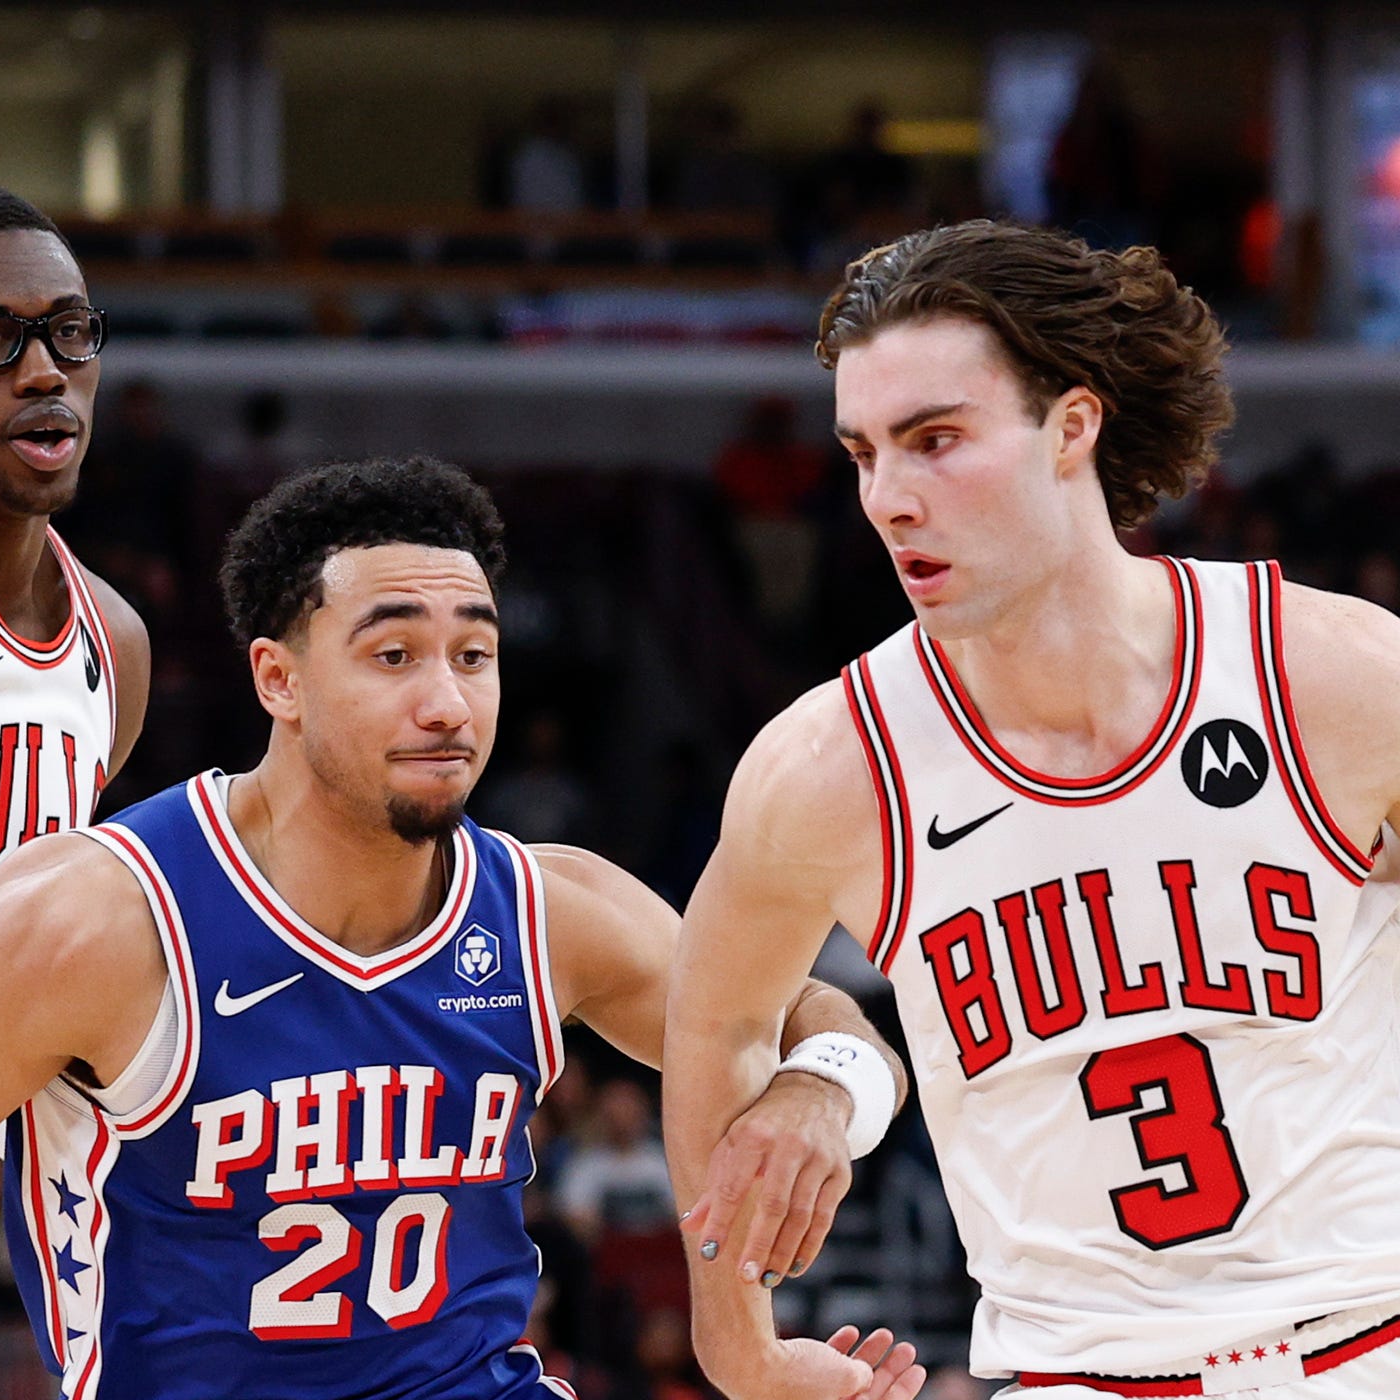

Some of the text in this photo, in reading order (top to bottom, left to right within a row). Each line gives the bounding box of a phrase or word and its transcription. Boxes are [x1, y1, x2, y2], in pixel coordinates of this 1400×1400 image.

[438, 994, 522, 1013] crypto.com
[919, 860, 1323, 1080] BULLS
[185, 1065, 523, 1209] PHILA
[1078, 1031, 1250, 1252] 3
[248, 1193, 452, 1341] 20
